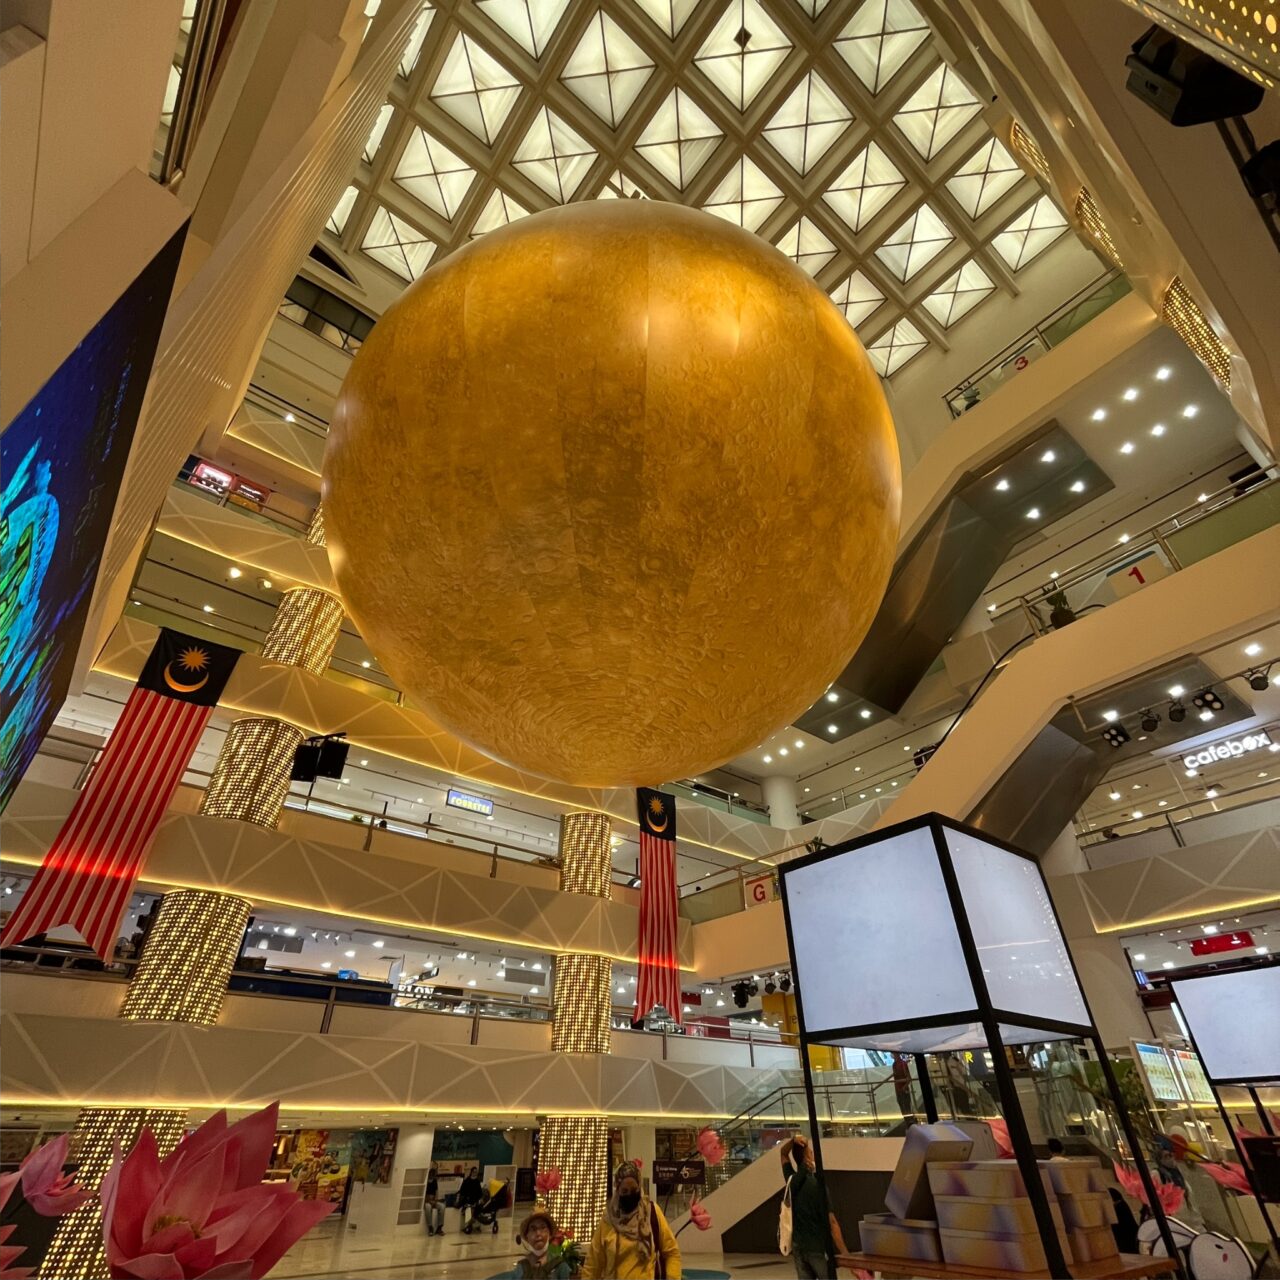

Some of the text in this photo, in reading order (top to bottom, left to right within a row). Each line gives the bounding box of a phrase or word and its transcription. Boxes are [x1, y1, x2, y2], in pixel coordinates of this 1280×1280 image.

[1014, 356, 1029, 371] 3
[1128, 566, 1146, 585] 1
[1183, 732, 1272, 769] cafebox
[753, 883, 766, 902] G
